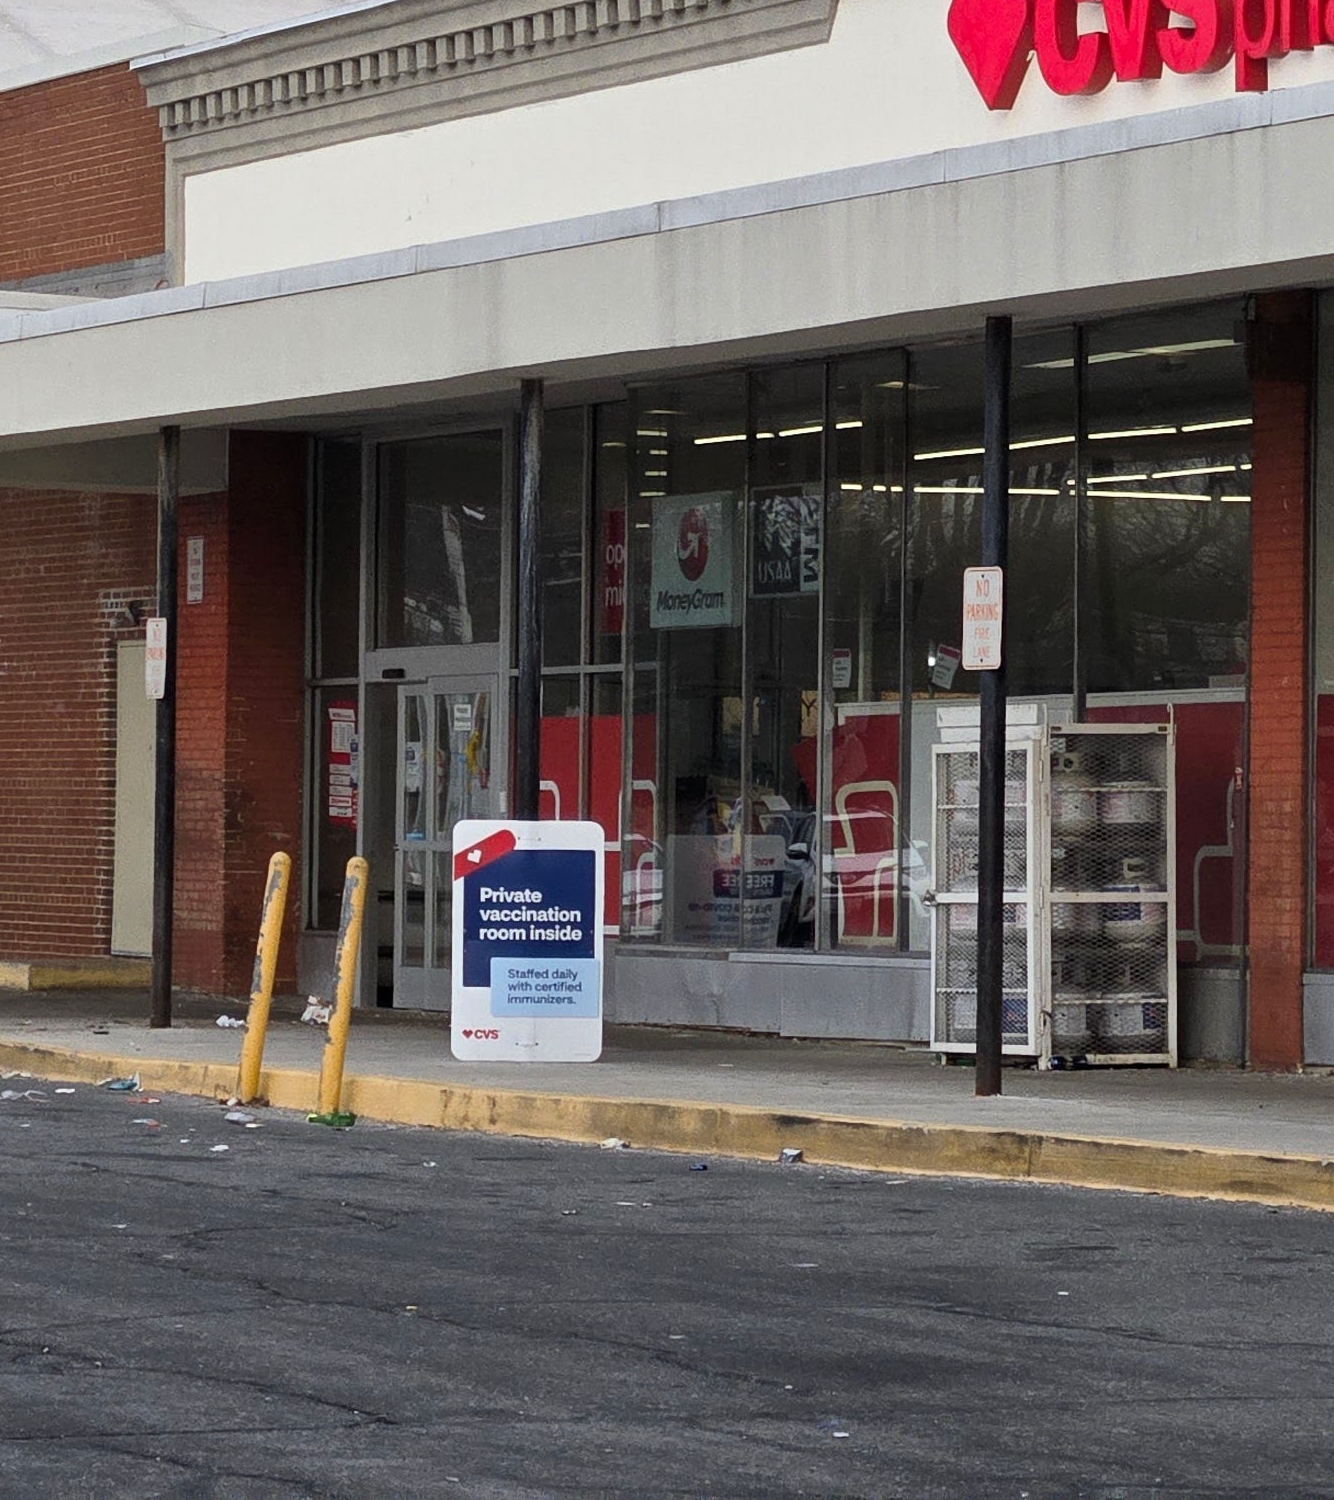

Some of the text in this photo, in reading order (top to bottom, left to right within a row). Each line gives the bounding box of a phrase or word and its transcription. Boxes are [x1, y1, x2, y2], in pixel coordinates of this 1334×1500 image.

[605, 543, 625, 570] op
[758, 558, 793, 583] USAA
[605, 578, 625, 607] mi
[975, 579, 990, 598] NO
[657, 588, 725, 615] MoneyGram
[966, 603, 999, 621] PARKING
[480, 886, 543, 903] Private
[479, 906, 582, 922] vaccination
[479, 924, 582, 941] room inside
[507, 968, 578, 983] Staffed daily
[507, 981, 582, 992] with certified
[507, 993, 576, 1005] immunizers.
[474, 1029, 499, 1040] CVS
